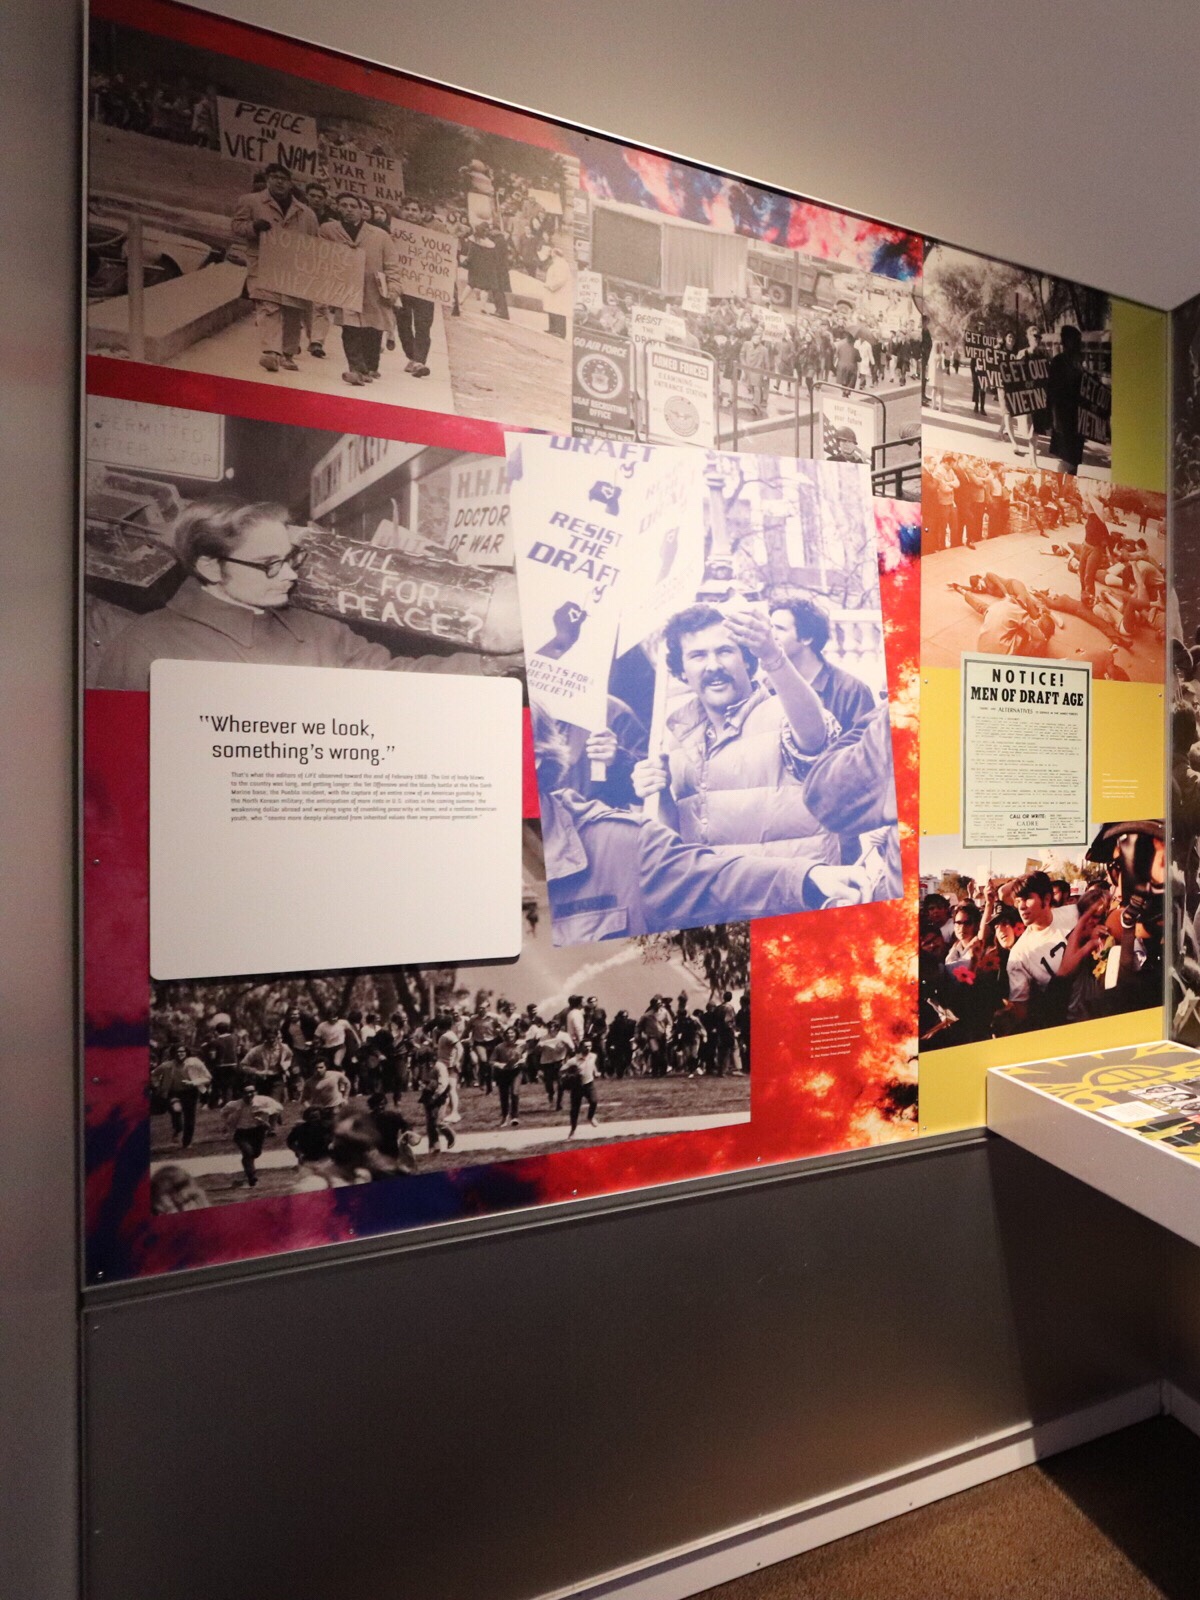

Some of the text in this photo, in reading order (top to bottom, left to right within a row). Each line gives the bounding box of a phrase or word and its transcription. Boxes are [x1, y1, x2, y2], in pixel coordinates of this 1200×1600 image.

[235, 102, 306, 134] PEACE
[261, 128, 276, 140] IN
[224, 131, 319, 175] VIET NAM
[328, 147, 396, 171] END THE
[333, 162, 386, 184] WAR IN
[333, 177, 404, 202] VIET NAM
[421, 236, 452, 255] YOUR
[420, 261, 450, 278] YOUR
[417, 285, 450, 303] CARD
[634, 313, 663, 327] RESIST
[585, 339, 601, 352] AIR
[602, 344, 628, 358] FORCE
[965, 331, 998, 348] GET OUT
[653, 354, 708, 379] ARMED FORCES
[1000, 358, 1049, 383] GET OUT
[590, 400, 628, 415] RECRUITING
[1006, 387, 1047, 416] VIETNA
[589, 408, 612, 420] OFFICE
[549, 436, 657, 463] DRAFT
[454, 504, 511, 529] DOCTOR
[548, 511, 623, 548] RESIST
[450, 534, 467, 552] OF
[469, 533, 505, 554] WAR
[568, 534, 609, 560] THE
[340, 547, 400, 576] KILL
[526, 541, 621, 587] DRAFT
[381, 576, 439, 610] FOR
[337, 590, 484, 644] PEACE?
[992, 668, 1064, 687] NOTICE!
[528, 679, 575, 699] SOCIETY
[970, 686, 1084, 707] MEN OF DRAFT AGE
[998, 706, 1033, 715] ALTERNATIVES
[301, 720, 326, 735] we
[332, 719, 375, 740] look,
